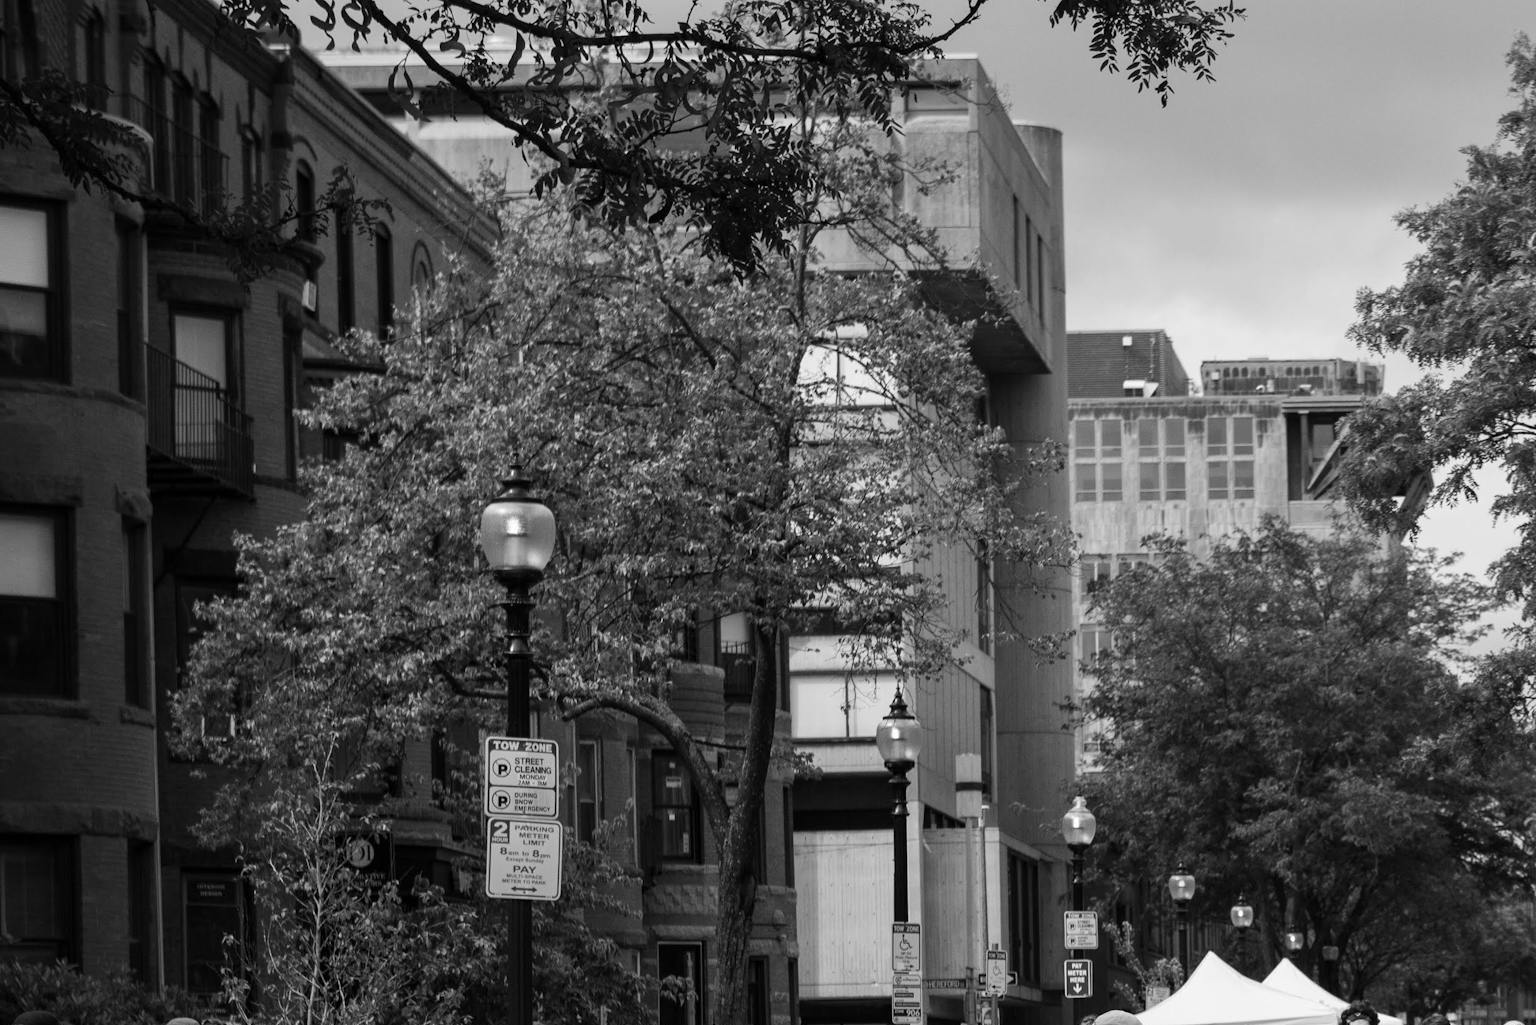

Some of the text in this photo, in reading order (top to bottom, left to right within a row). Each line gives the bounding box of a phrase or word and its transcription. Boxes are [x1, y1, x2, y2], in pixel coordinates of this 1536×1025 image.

[493, 741, 553, 753] TOW ZONE
[515, 757, 544, 766] STREET
[515, 766, 552, 774] CLEANING
[494, 822, 508, 837] 2
[514, 825, 554, 833] PARKING
[519, 832, 550, 840] METER
[513, 865, 536, 873] PAY
